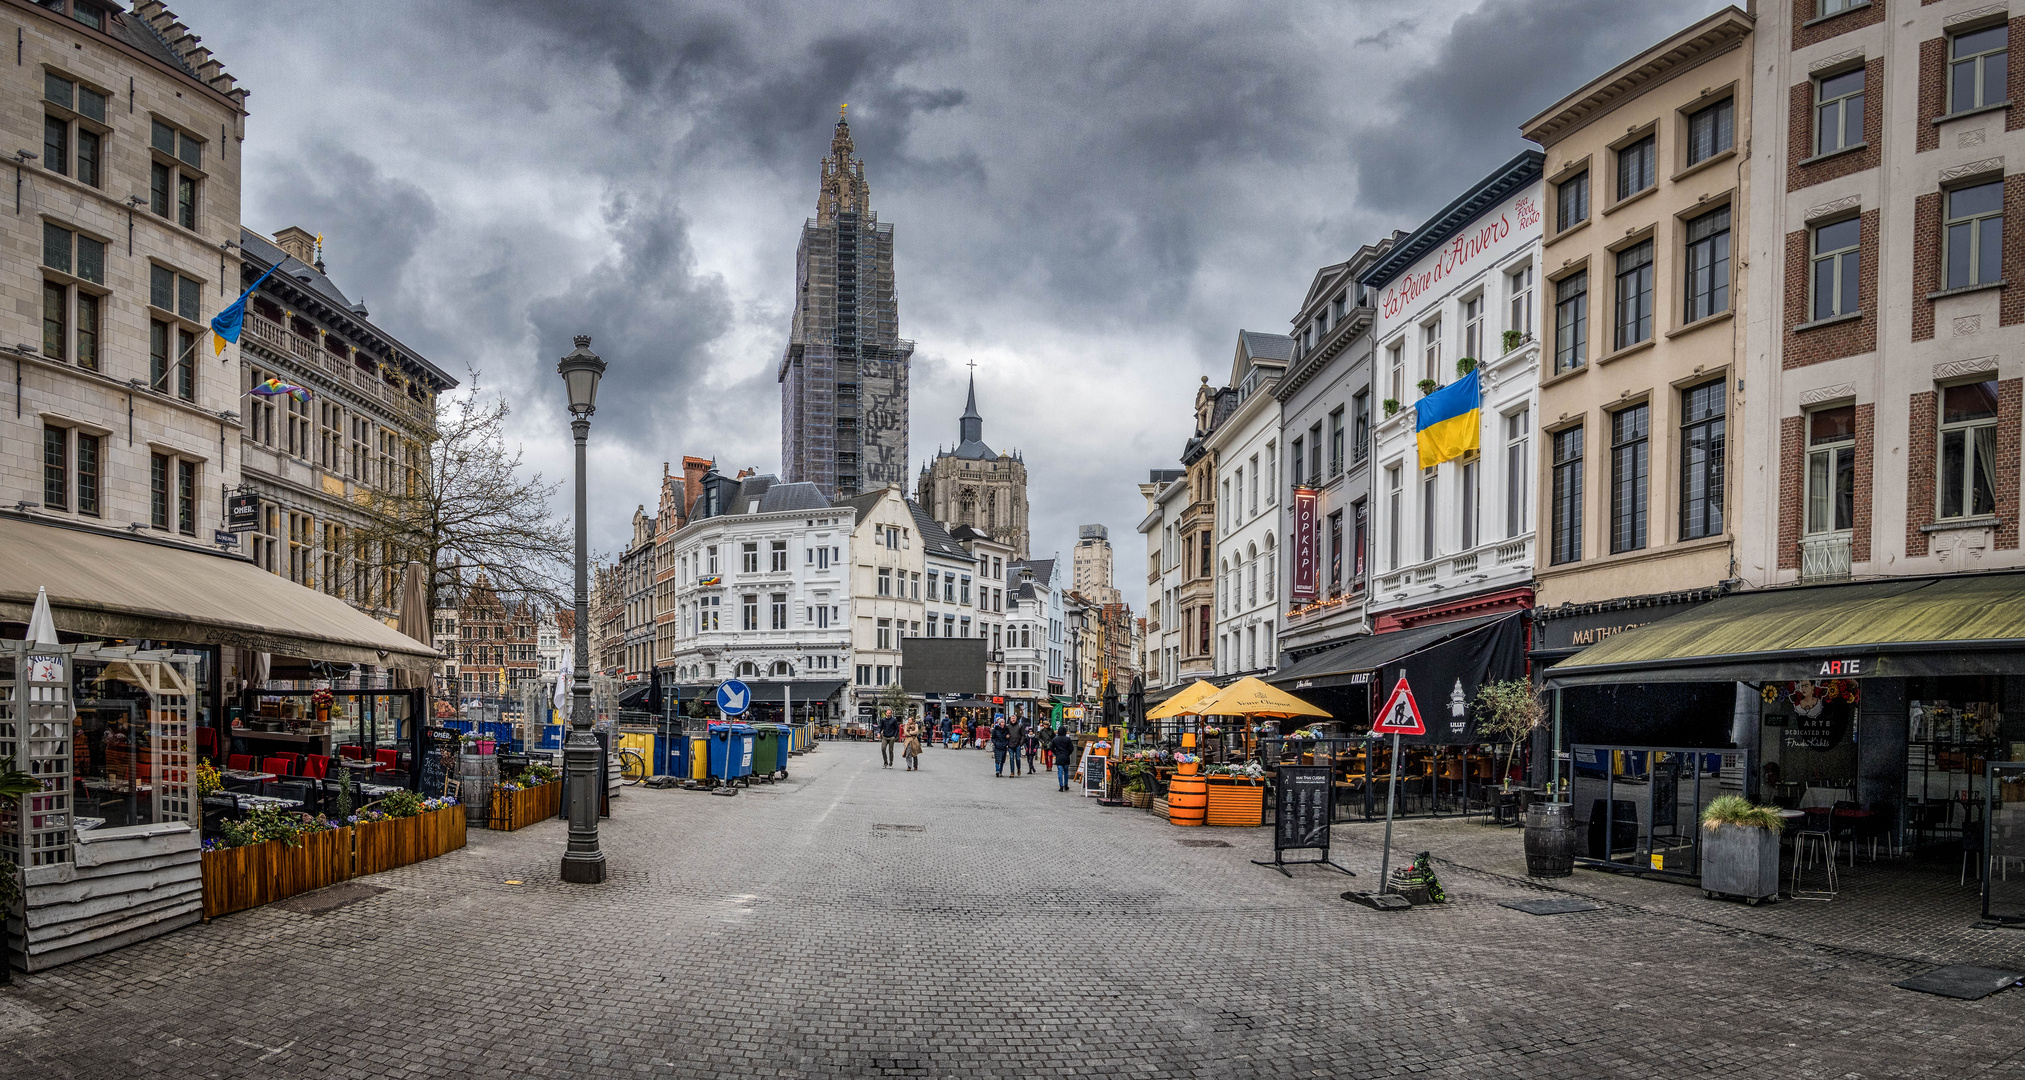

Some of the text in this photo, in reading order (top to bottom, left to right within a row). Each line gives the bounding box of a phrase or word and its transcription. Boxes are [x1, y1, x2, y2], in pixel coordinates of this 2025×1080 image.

[1515, 197, 1529, 211] Sea
[1517, 200, 1535, 220] Food
[1519, 210, 1540, 231] Resto
[1396, 271, 1432, 317] Reine
[1433, 213, 1510, 283] d'Anvers
[1301, 499, 1310, 581] TOPKAPI
[1573, 629, 1594, 645] MAI
[1820, 660, 1860, 675] ARTE
[1351, 673, 1370, 684] LILLET
[1785, 737, 1810, 747] Frida
